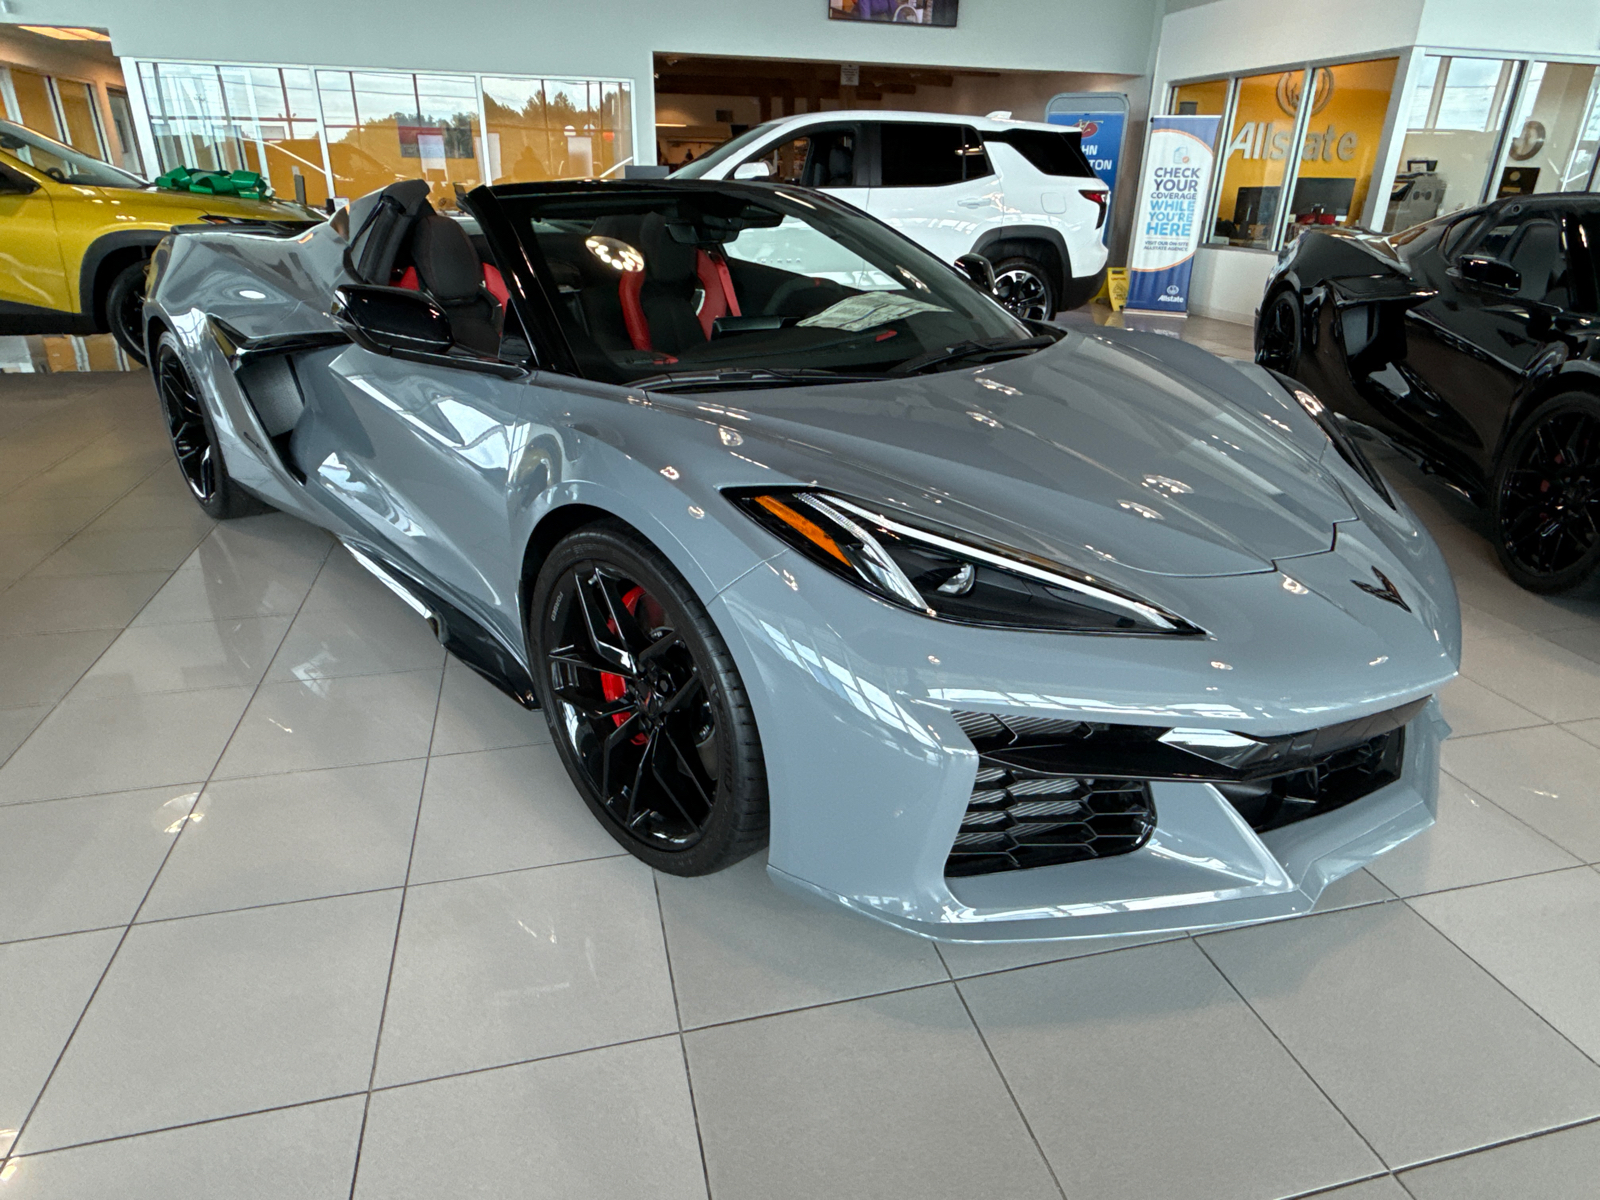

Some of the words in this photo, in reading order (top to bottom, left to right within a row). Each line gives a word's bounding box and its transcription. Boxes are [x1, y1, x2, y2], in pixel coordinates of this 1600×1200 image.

[1081, 144, 1098, 156] HN
[1088, 159, 1113, 171] TON
[1154, 167, 1200, 178] CHECK
[1154, 179, 1198, 192] YOUR
[1150, 200, 1195, 212] WHILE
[1149, 211, 1194, 223] YOU'RE
[1146, 222, 1191, 236] HERE
[1157, 294, 1184, 303] Allstate
